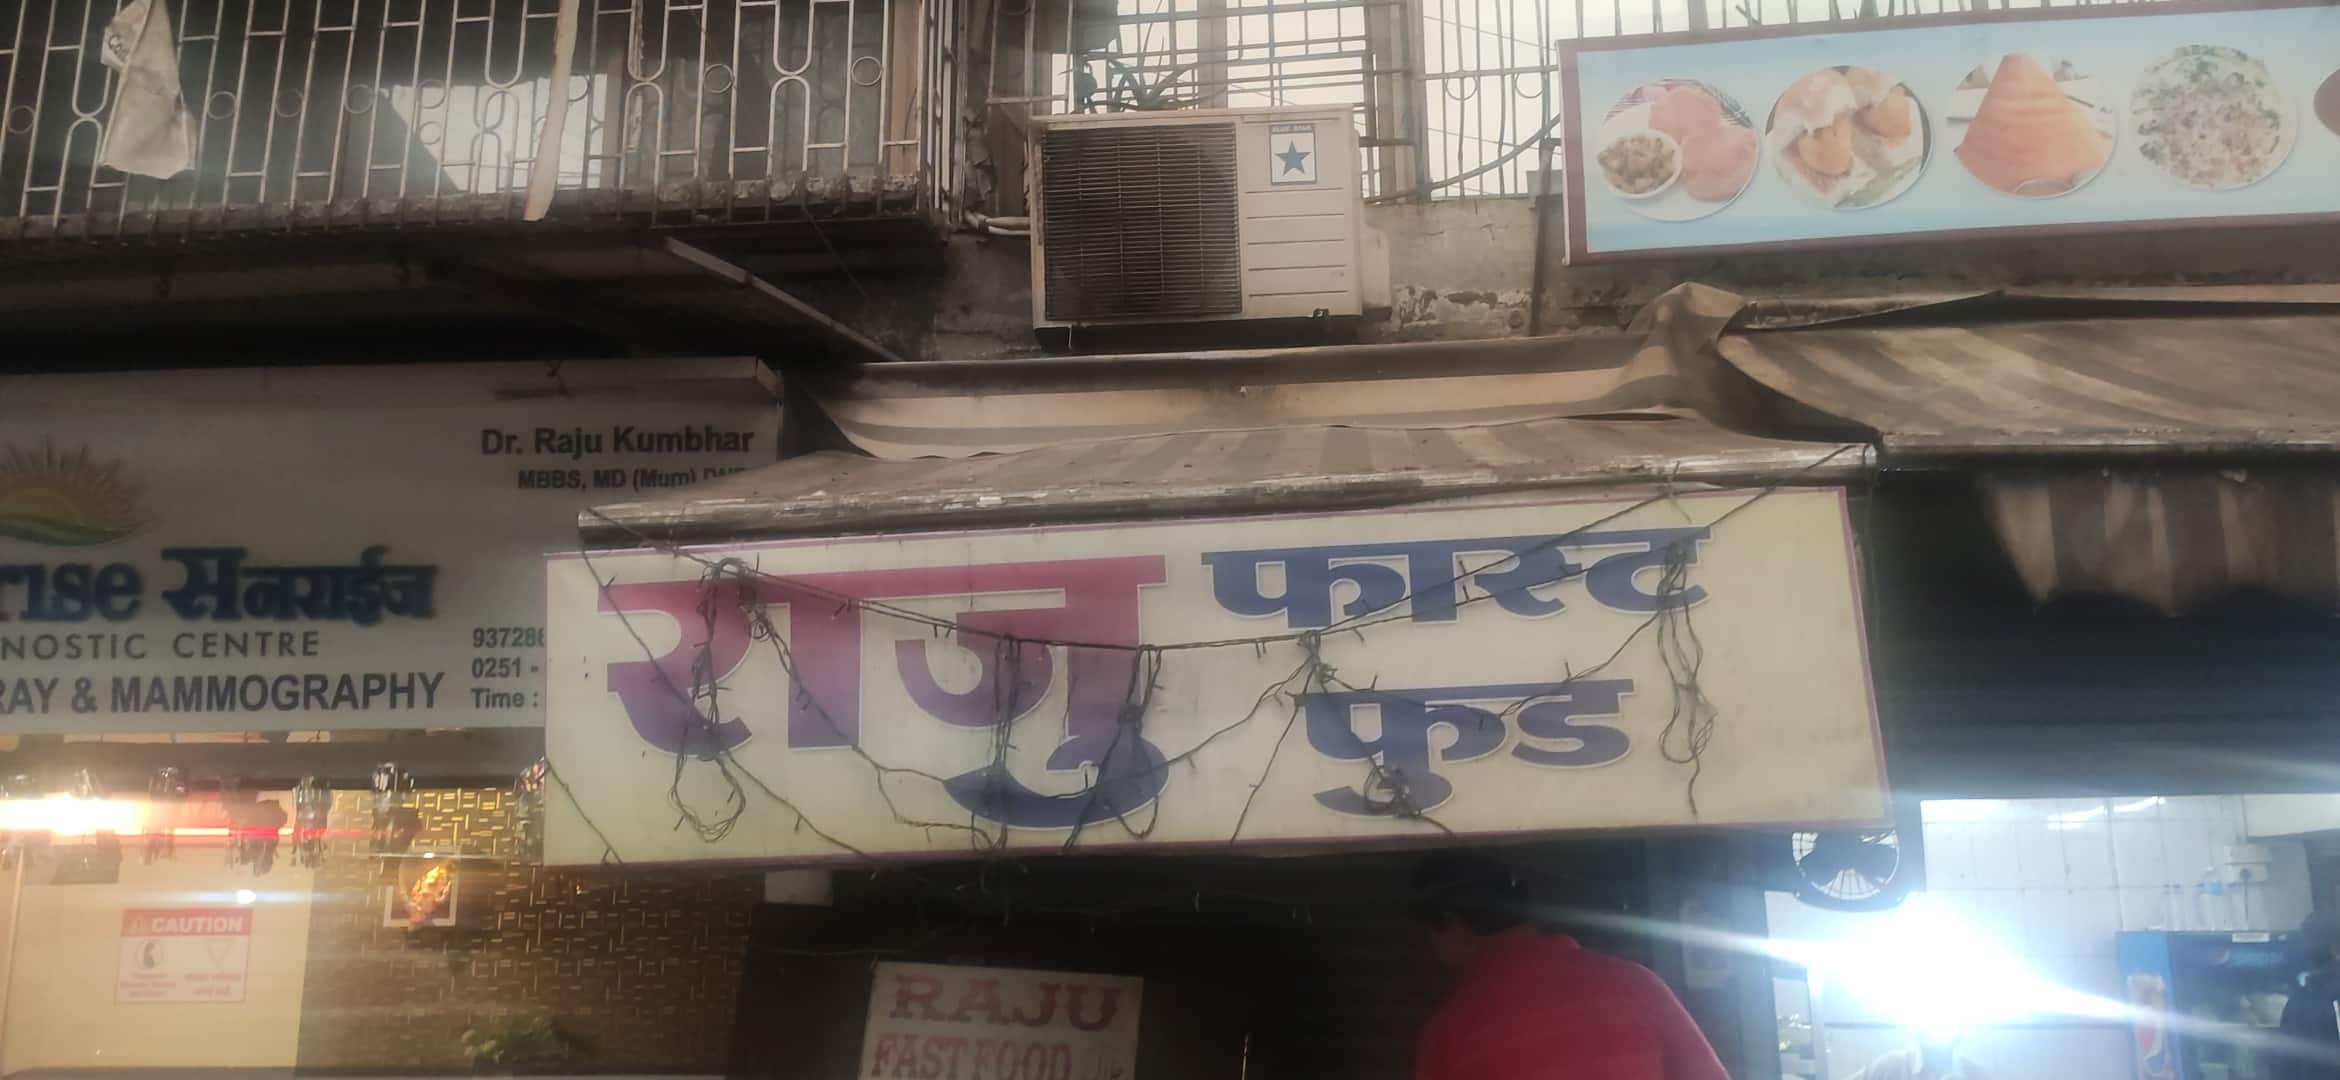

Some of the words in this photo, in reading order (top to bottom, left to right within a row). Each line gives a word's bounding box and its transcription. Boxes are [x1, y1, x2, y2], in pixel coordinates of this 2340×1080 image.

[481, 429, 523, 455] Dr.
[535, 427, 603, 460] Raju
[612, 425, 755, 454] Kumbhar
[517, 469, 587, 492] MBBS,
[593, 468, 626, 488] MD
[1201, 526, 1713, 631] फास्ट
[1, 632, 146, 660] NOSTIC
[173, 630, 320, 659] CENTRE
[471, 656, 521, 679] 0251
[71, 675, 97, 714] &
[110, 671, 445, 713] MAMMOGRAPHY
[471, 687, 526, 710] Time
[1296, 678, 1635, 818] फुड
[151, 916, 243, 933] CAUTION
[889, 974, 1123, 1032] RAJU
[871, 1032, 970, 1080] FAST
[972, 1038, 1073, 1080] FOOD
